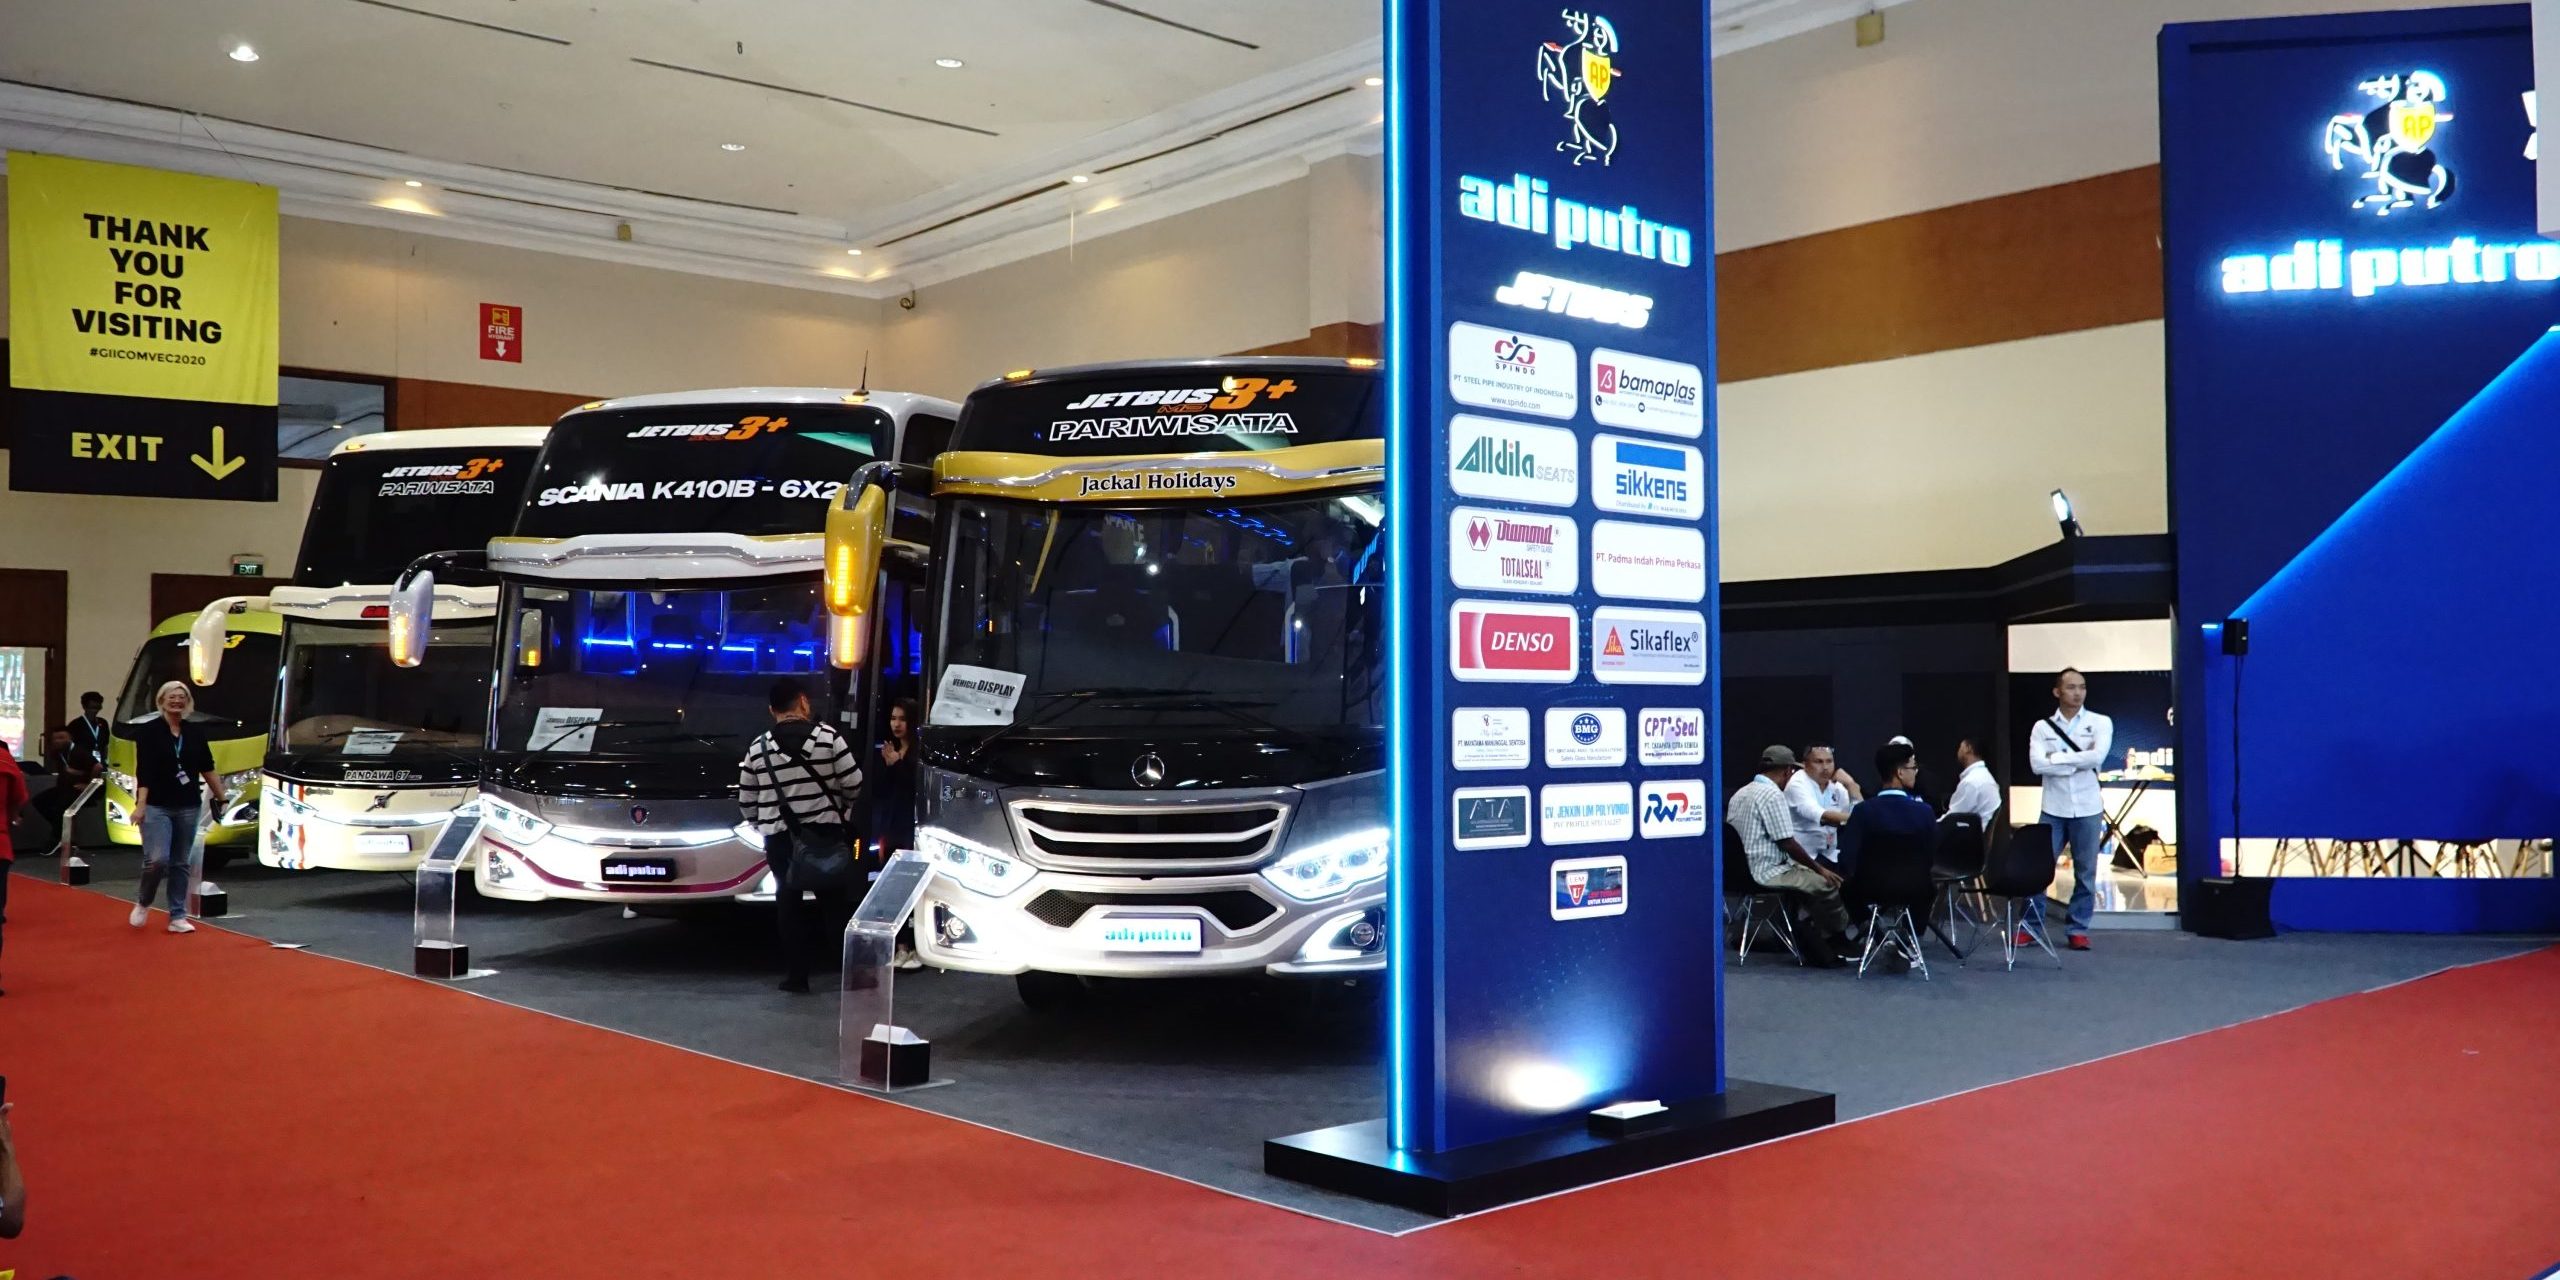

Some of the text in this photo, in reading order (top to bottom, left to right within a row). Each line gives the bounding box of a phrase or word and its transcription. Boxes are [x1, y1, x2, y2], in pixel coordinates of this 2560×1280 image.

[1590, 61, 1608, 90] AP
[2403, 114, 2433, 138] AP
[84, 213, 209, 251] THANK
[1460, 173, 1691, 267] adi putro
[110, 248, 183, 278] YOU
[2221, 236, 2560, 297] adi putro
[115, 281, 181, 309] FOR
[1495, 271, 1654, 328] JETBUS
[72, 308, 222, 344] VISITING
[488, 324, 514, 336] FIRE
[90, 348, 206, 366] #GIICOMVEC2020
[1495, 362, 1536, 375] SPINDO
[1463, 376, 1481, 385] STEEL
[1482, 378, 1495, 387] PIPE
[1496, 380, 1524, 392] INDUSTRY
[1533, 387, 1563, 397] INDONESIA
[1619, 369, 1696, 401] bamaplas
[1491, 396, 1541, 409] www.spindo.com
[1049, 413, 1298, 442] PARIWISATA
[72, 432, 163, 461] EXIT
[1455, 436, 1575, 483] Alldila SEATS
[378, 480, 494, 496] PARIWISATA
[538, 483, 645, 507] SCANIA
[652, 479, 756, 499] K410IB
[1080, 472, 1236, 496] Jackal Holidays
[1616, 468, 1686, 501] sikkens
[239, 564, 258, 574] EXIT
[1500, 557, 1543, 579] TOTALSEAL
[1608, 553, 1632, 564] Padma
[1634, 555, 1654, 566] Indah
[1656, 557, 1675, 568] Prima
[1676, 559, 1701, 569] Perkasa
[1491, 631, 1554, 652] DENSO
[952, 677, 977, 690] VEHICLE
[977, 679, 1015, 698] DISPLAY
[1574, 724, 1598, 734] BMG
[344, 770, 395, 780] PANDAWA
[605, 864, 667, 877] adi putro
